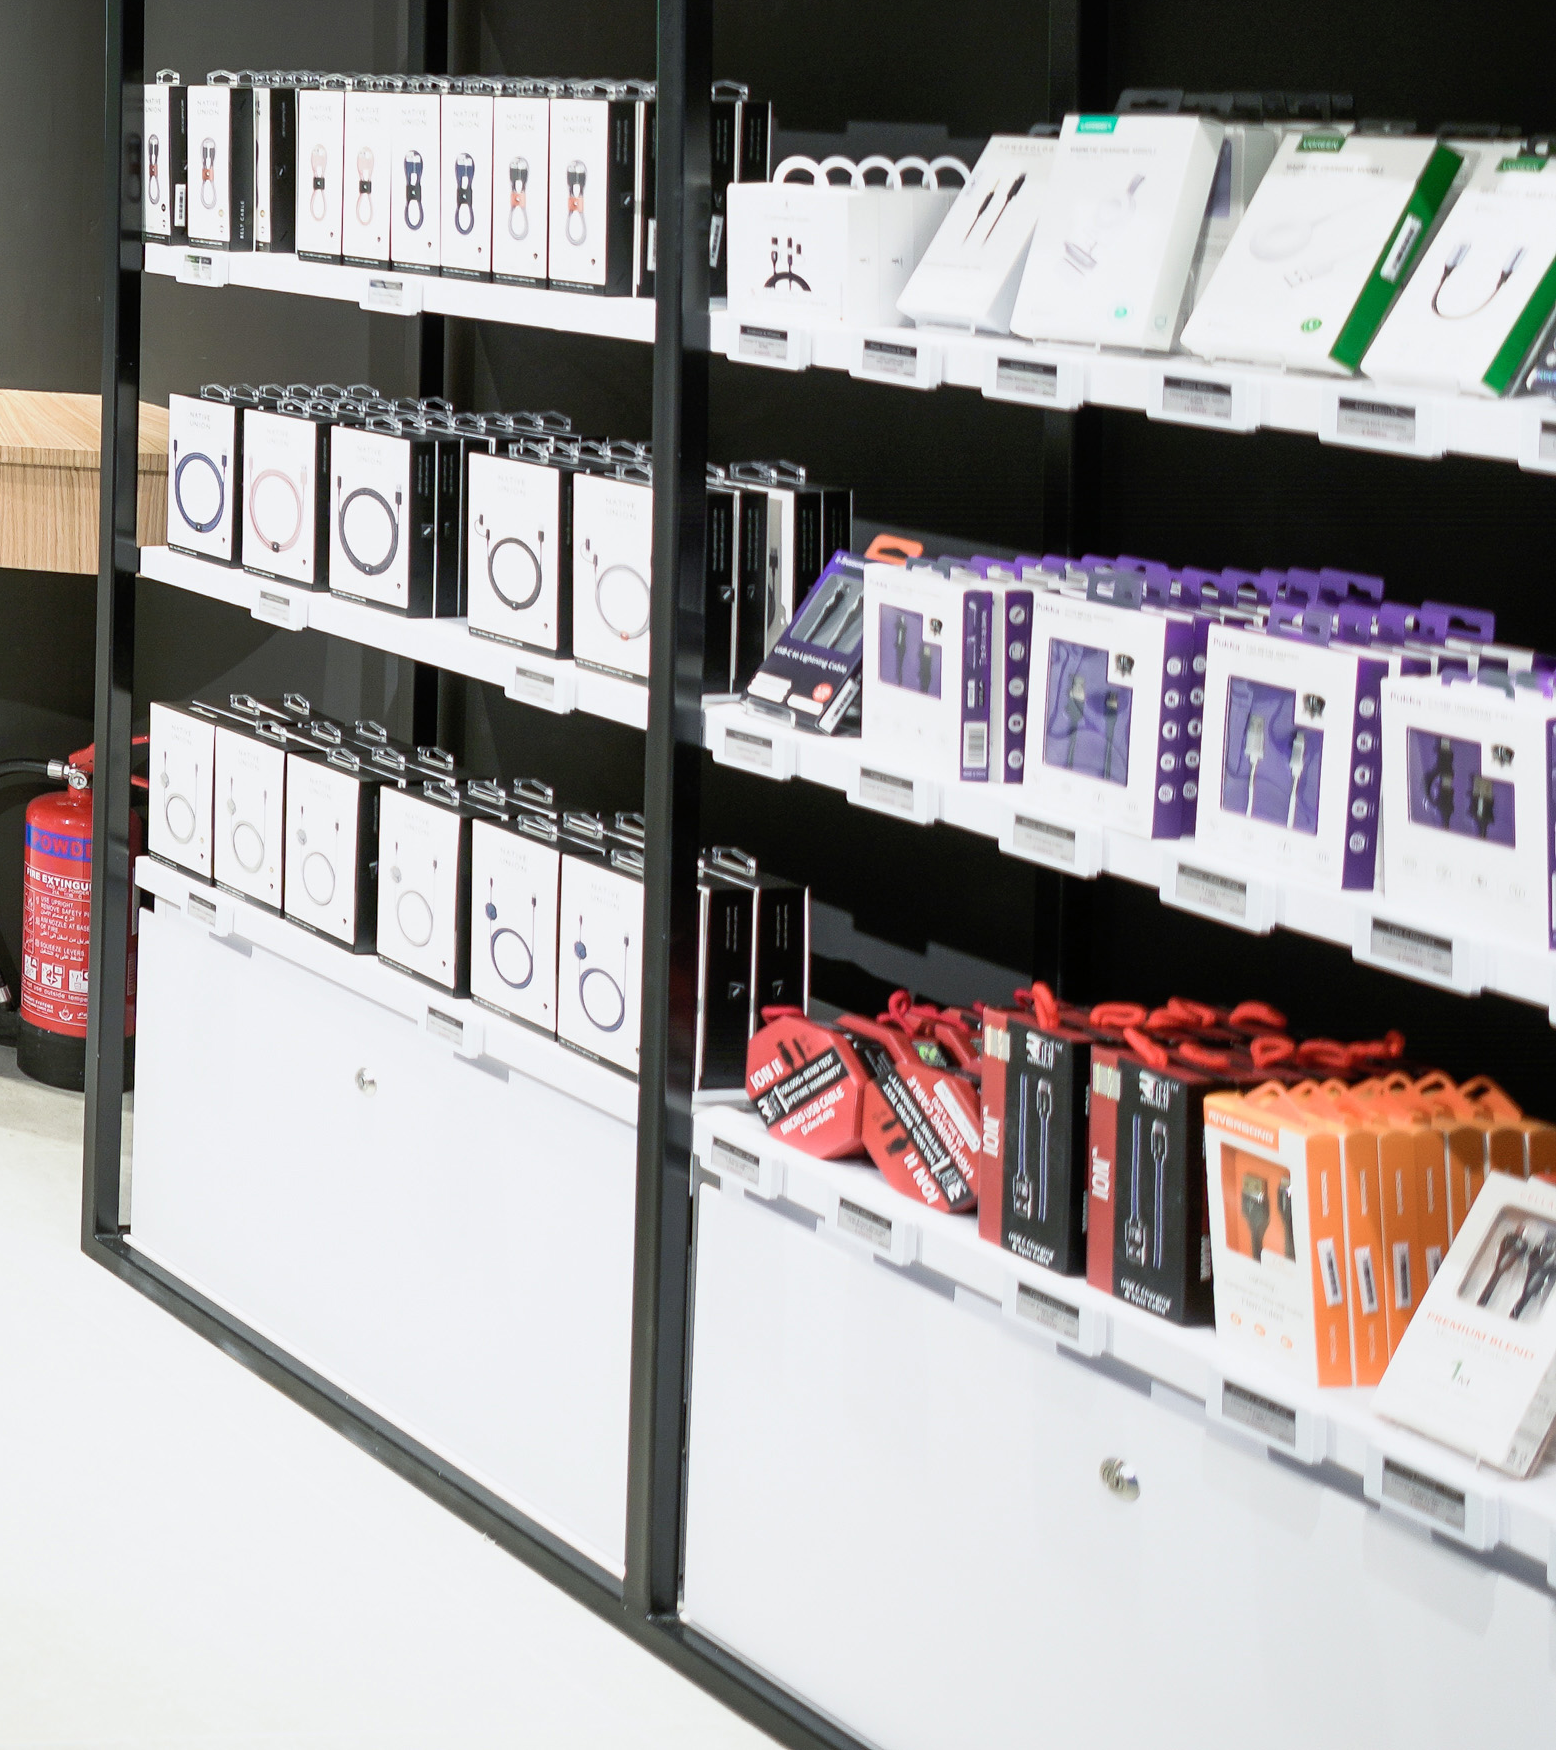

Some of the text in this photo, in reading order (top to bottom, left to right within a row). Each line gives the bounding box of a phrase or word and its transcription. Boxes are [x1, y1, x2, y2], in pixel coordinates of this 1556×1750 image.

[309, 115, 332, 123] UNION
[355, 116, 380, 124] UNION
[1035, 602, 1061, 616] Pukka
[1212, 636, 1241, 654] Pukka
[1390, 691, 1423, 708] Pukka
[27, 866, 41, 883] FIRE
[40, 896, 51, 904] USE
[40, 902, 61, 914] REMOVE
[61, 907, 82, 918] SAFETY
[40, 922, 59, 933] OF FIRE
[47, 917, 68, 929] NOZZLE
[76, 924, 90, 932] BASE
[40, 941, 63, 954] SQUEEZE
[63, 947, 85, 957] LEVERS
[33, 985, 65, 999] use outside
[816, 1051, 834, 1070] TEST
[749, 1064, 773, 1091] ION
[783, 1082, 808, 1108] LIFETIME
[780, 1108, 803, 1136] MICRO
[803, 1100, 820, 1122] USB
[818, 1084, 845, 1112] CABLE
[1208, 1109, 1275, 1145] RIVERSONG
[982, 1116, 1001, 1159] ION
[912, 1166, 941, 1205] ION
[1091, 1157, 1111, 1202] ION
[1427, 1311, 1535, 1360] PREMIUM BLEND
